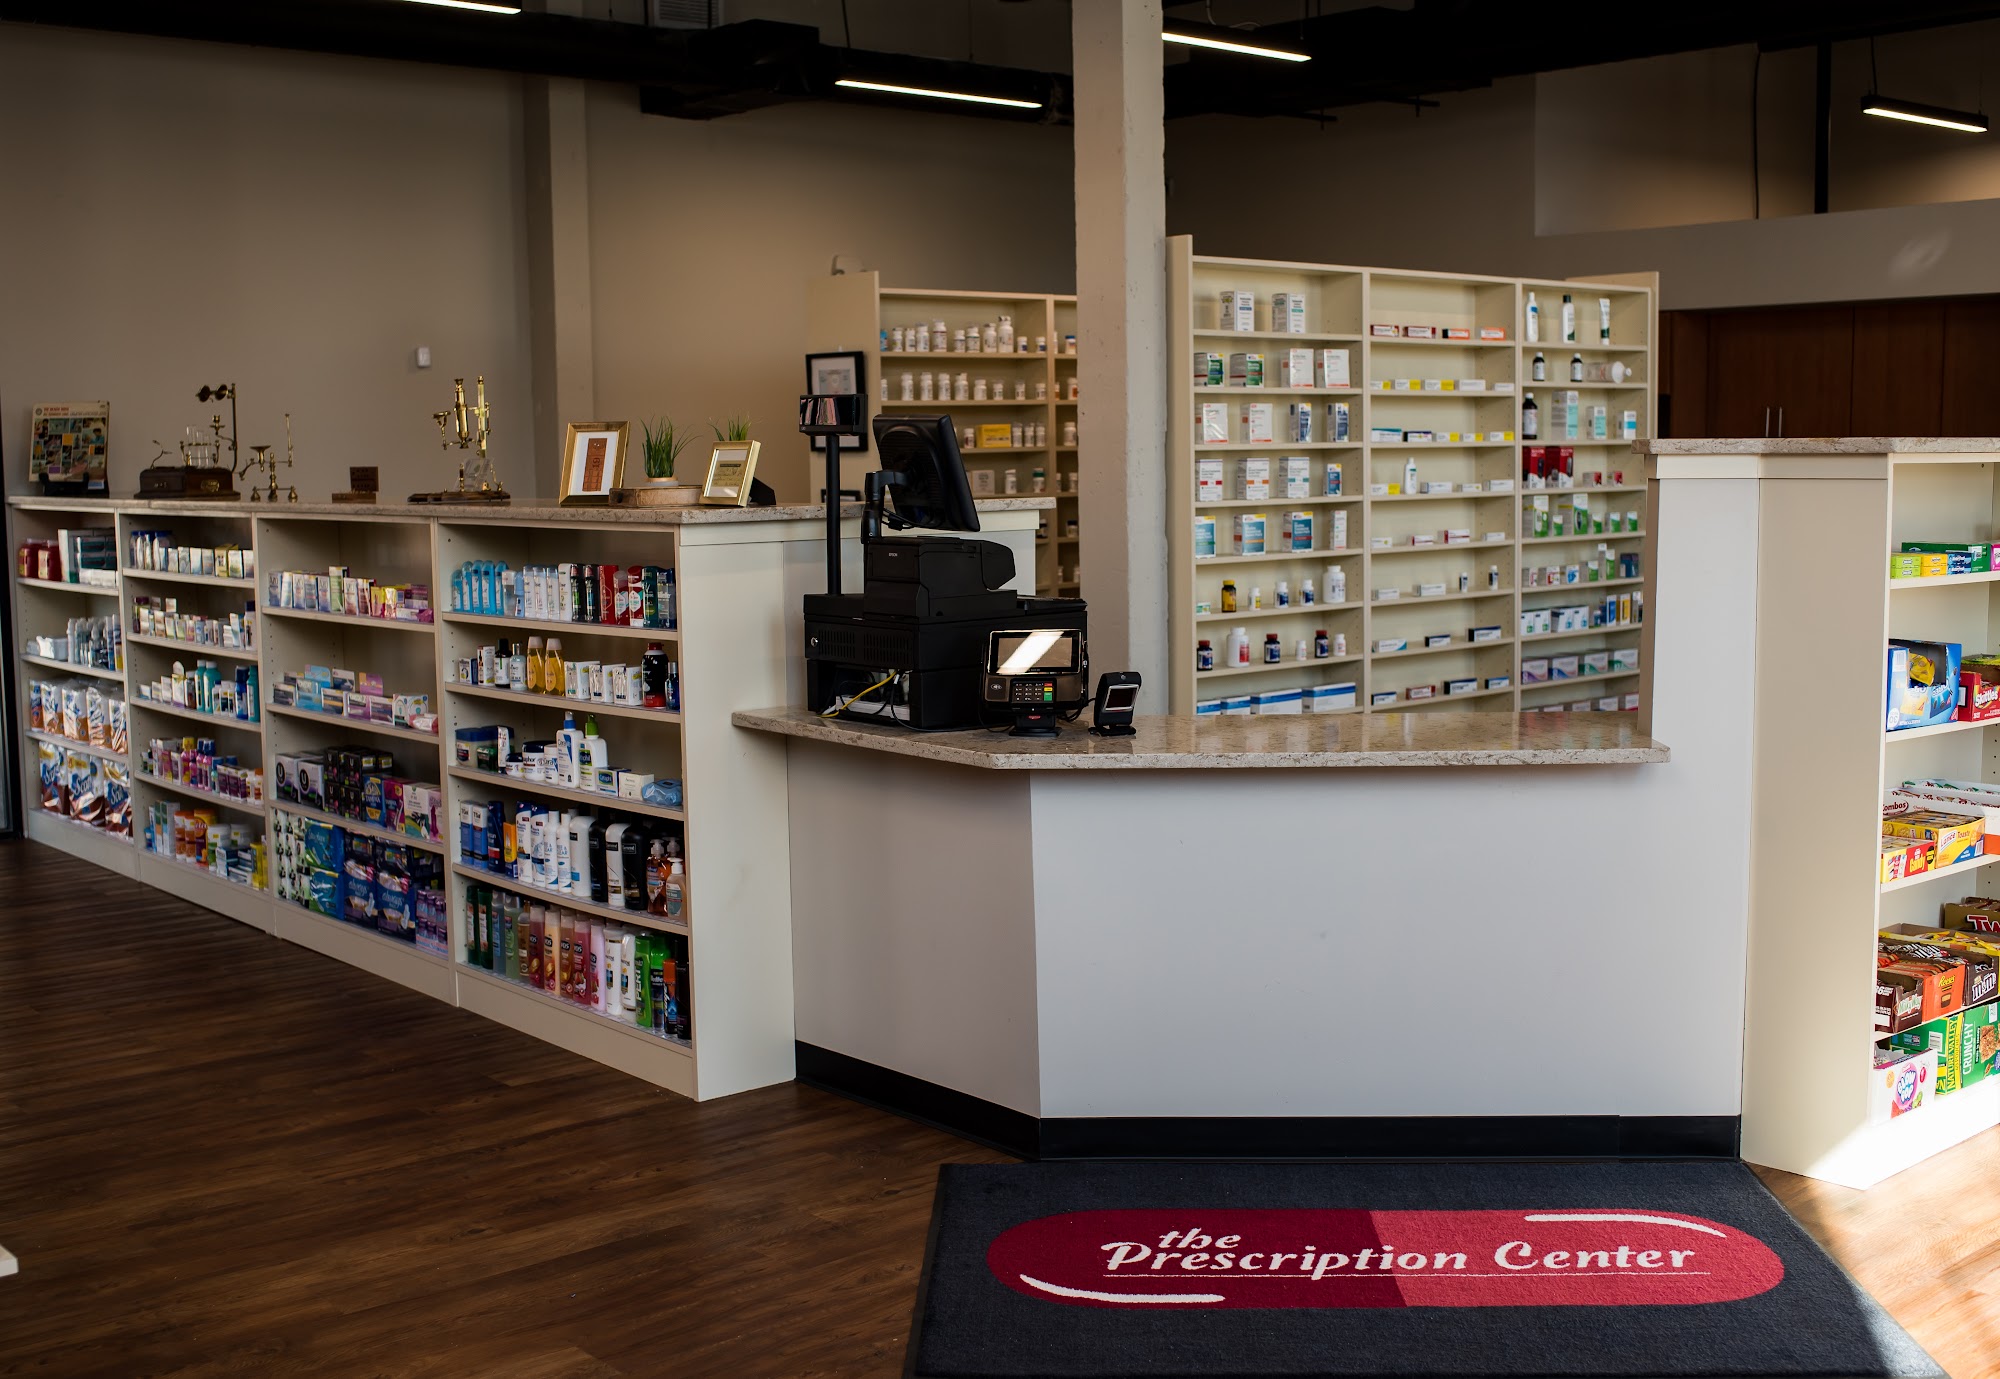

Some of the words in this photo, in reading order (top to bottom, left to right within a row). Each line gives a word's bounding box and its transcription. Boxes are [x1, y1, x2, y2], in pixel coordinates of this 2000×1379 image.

[1975, 689, 1998, 707] Skittles
[1941, 832, 1956, 847] Lance
[1948, 1019, 1958, 1053] VALLEY
[1962, 1023, 1974, 1075] CRUNCHY
[1947, 1053, 1957, 1089] NATURE
[1158, 1227, 1241, 1249] the
[1100, 1241, 1468, 1281] Prescription
[1493, 1240, 1696, 1271] Center
